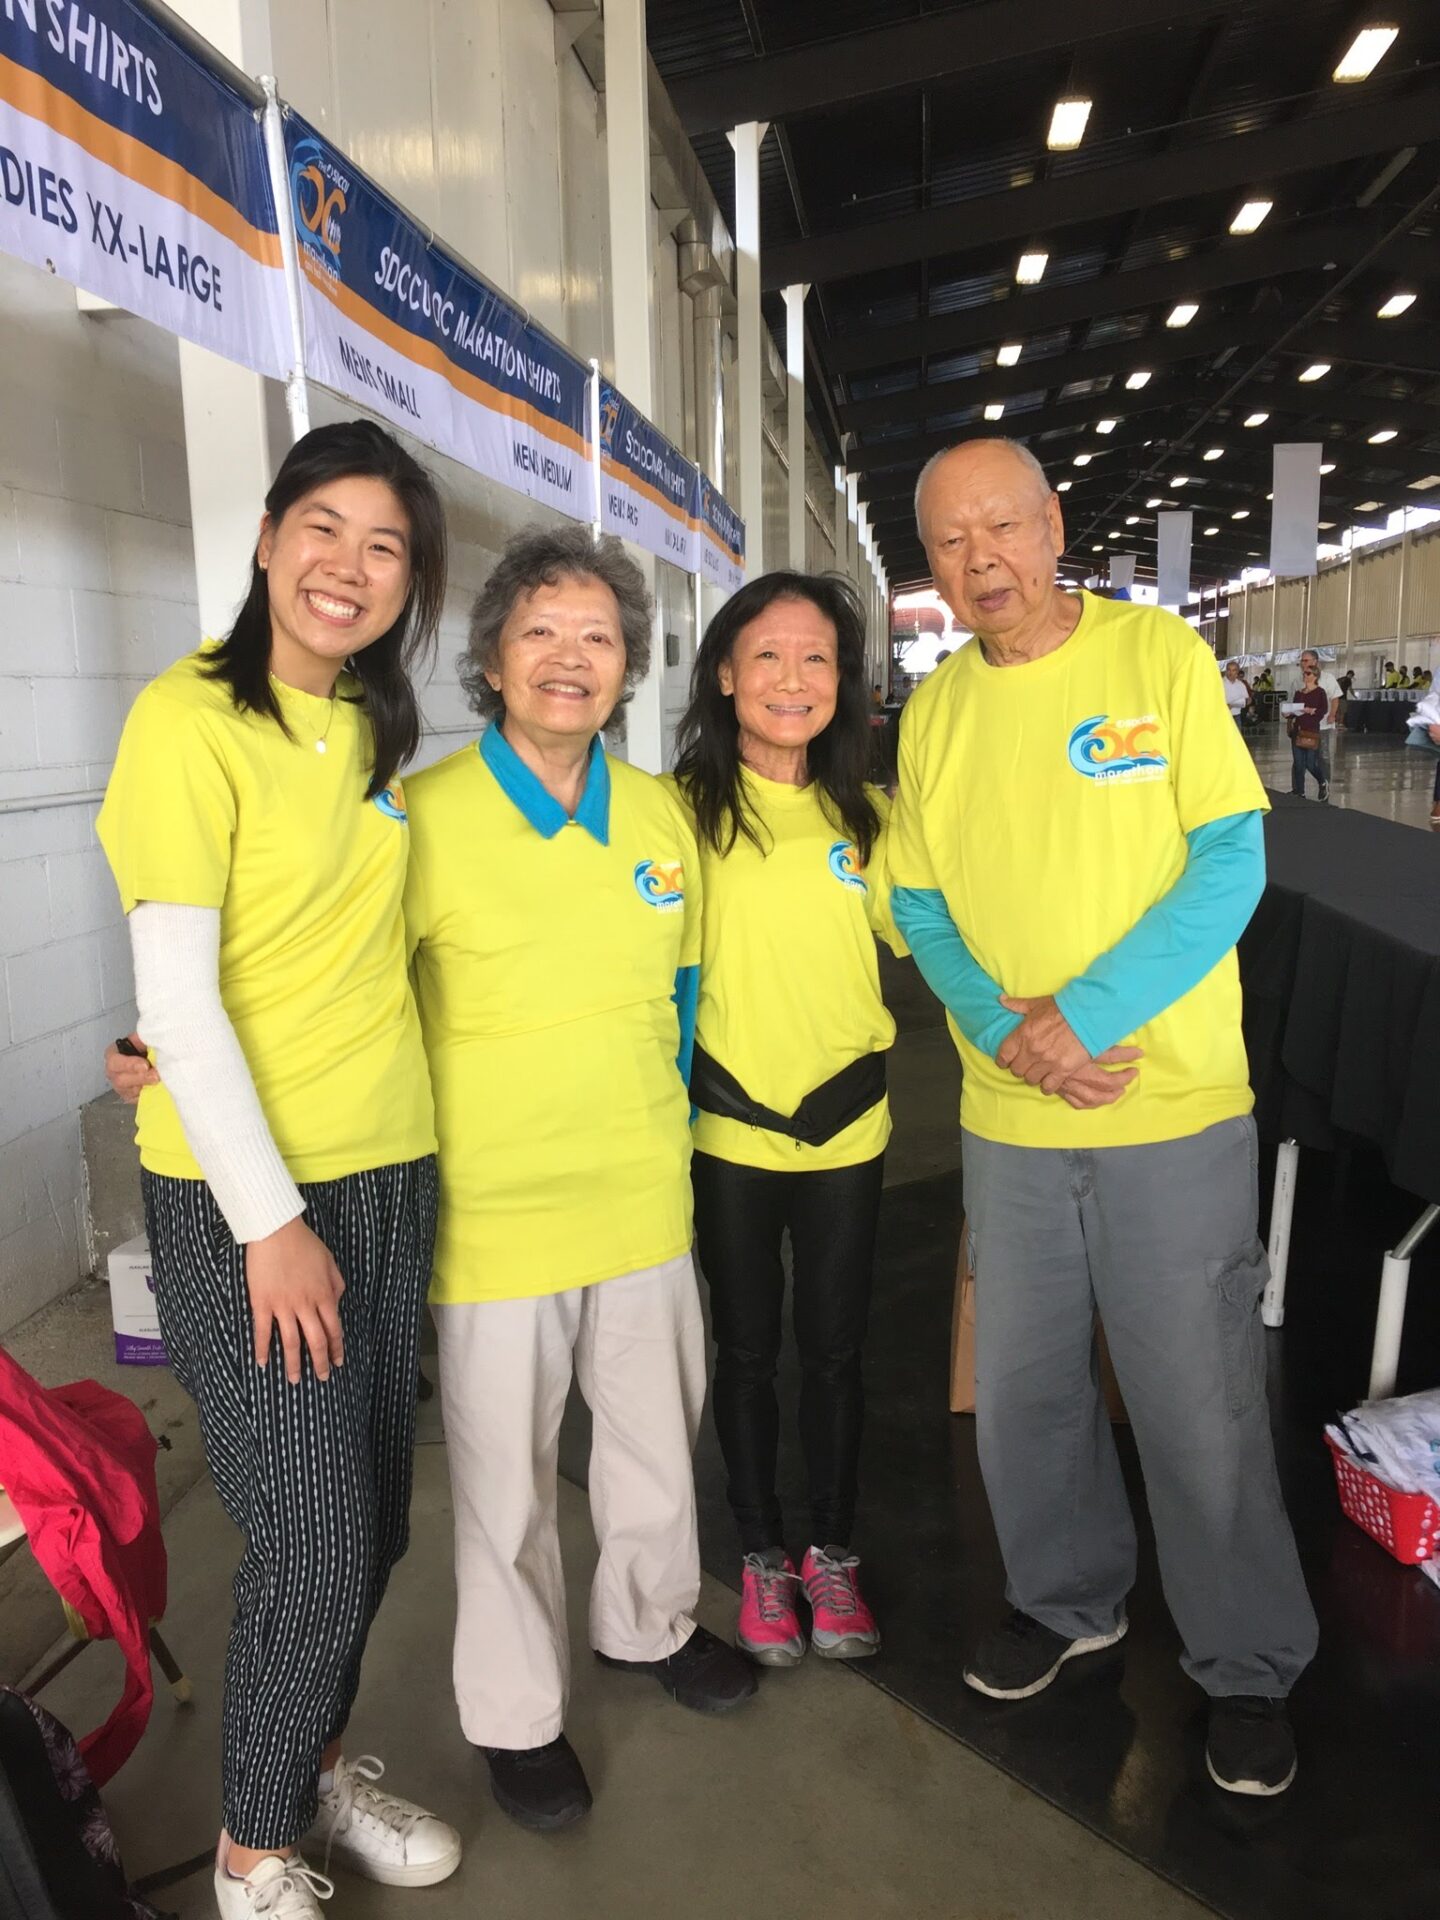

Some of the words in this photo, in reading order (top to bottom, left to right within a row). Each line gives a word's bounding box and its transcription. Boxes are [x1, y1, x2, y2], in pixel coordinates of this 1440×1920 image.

[46, 0, 163, 116] SHIRTS
[86, 191, 222, 312] XX-LARGE
[376, 366, 421, 419] SMALL
[528, 357, 561, 404] SHIRTS
[513, 439, 539, 476] MENS
